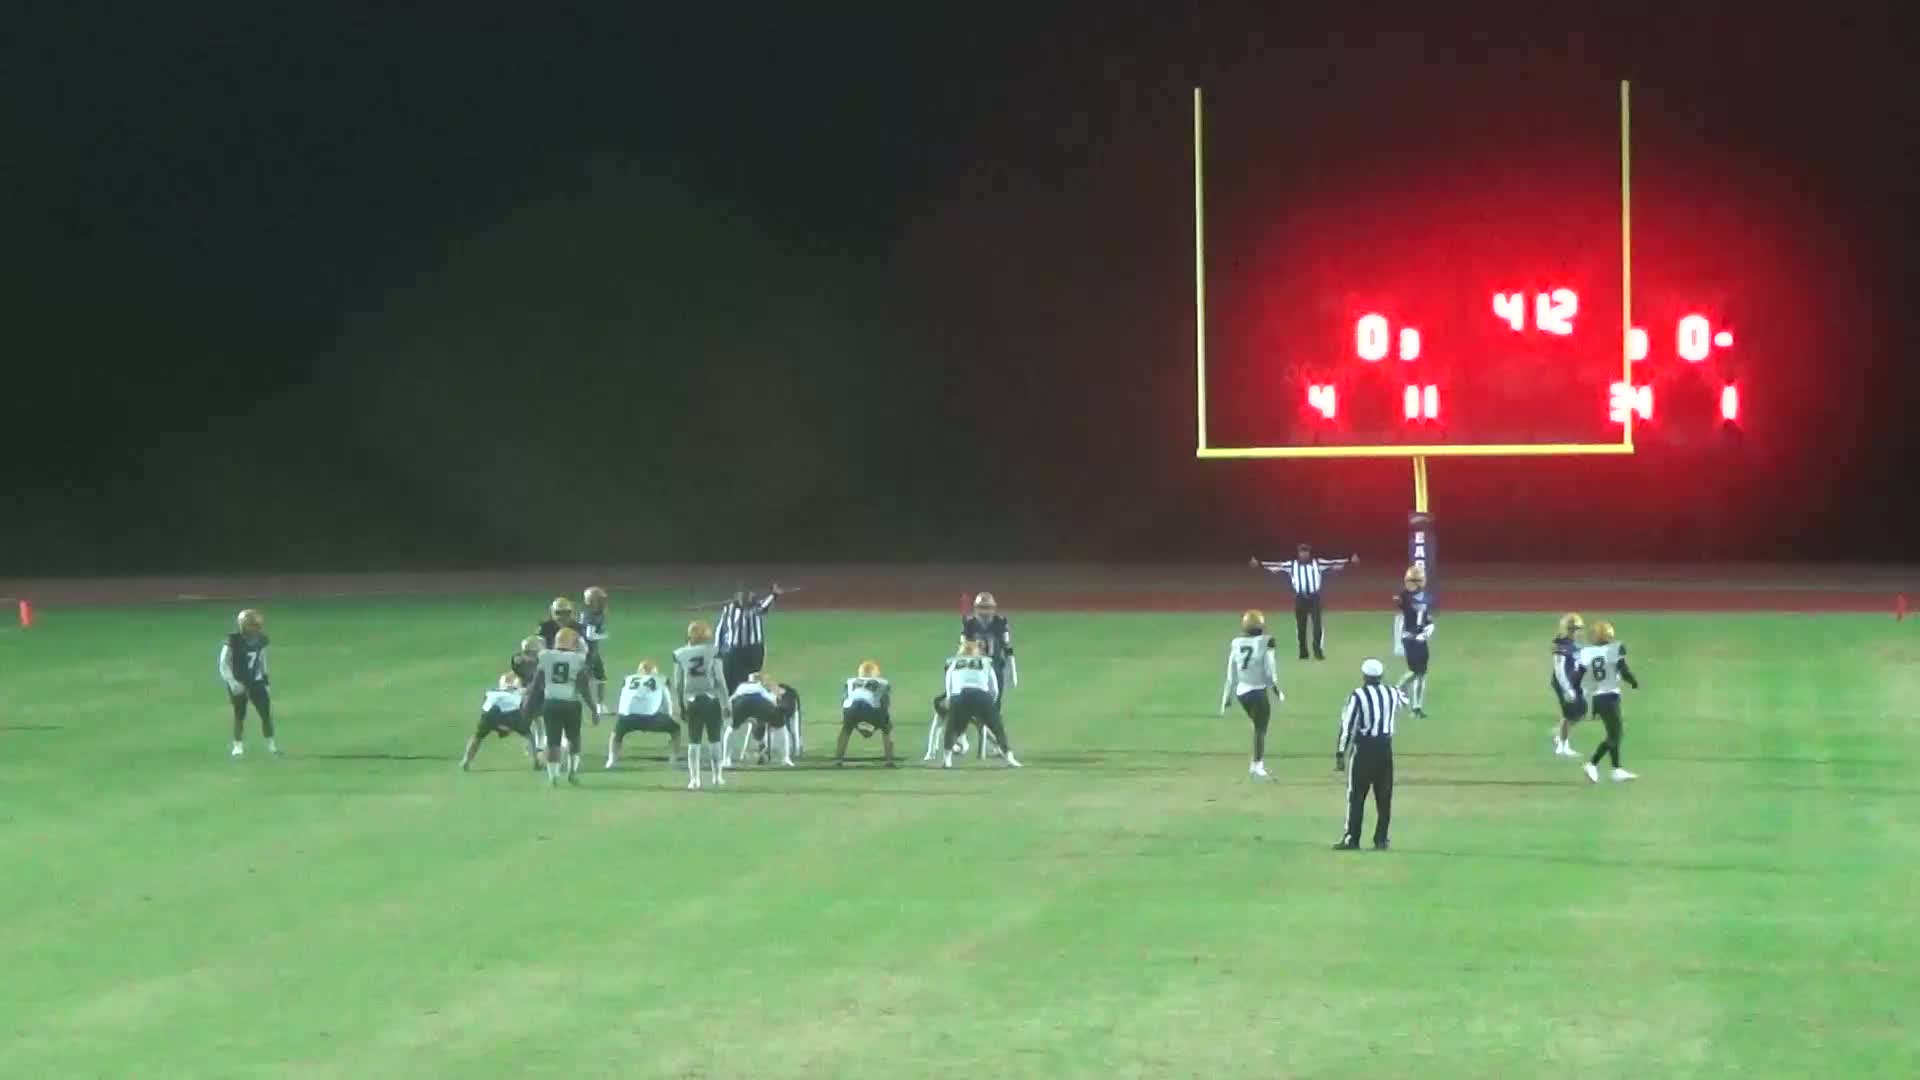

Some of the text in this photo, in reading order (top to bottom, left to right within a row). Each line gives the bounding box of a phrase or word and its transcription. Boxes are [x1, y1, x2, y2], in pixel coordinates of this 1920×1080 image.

[1357, 314, 1388, 361] 0
[1678, 314, 1710, 361] 0
[1308, 385, 1336, 418] 4
[1404, 385, 1438, 419] 11
[1722, 386, 1738, 420] 1
[247, 651, 257, 669] 7
[689, 655, 705, 677] 2
[1239, 646, 1254, 669] 7
[1592, 655, 1606, 681] 8
[551, 661, 570, 684] 9
